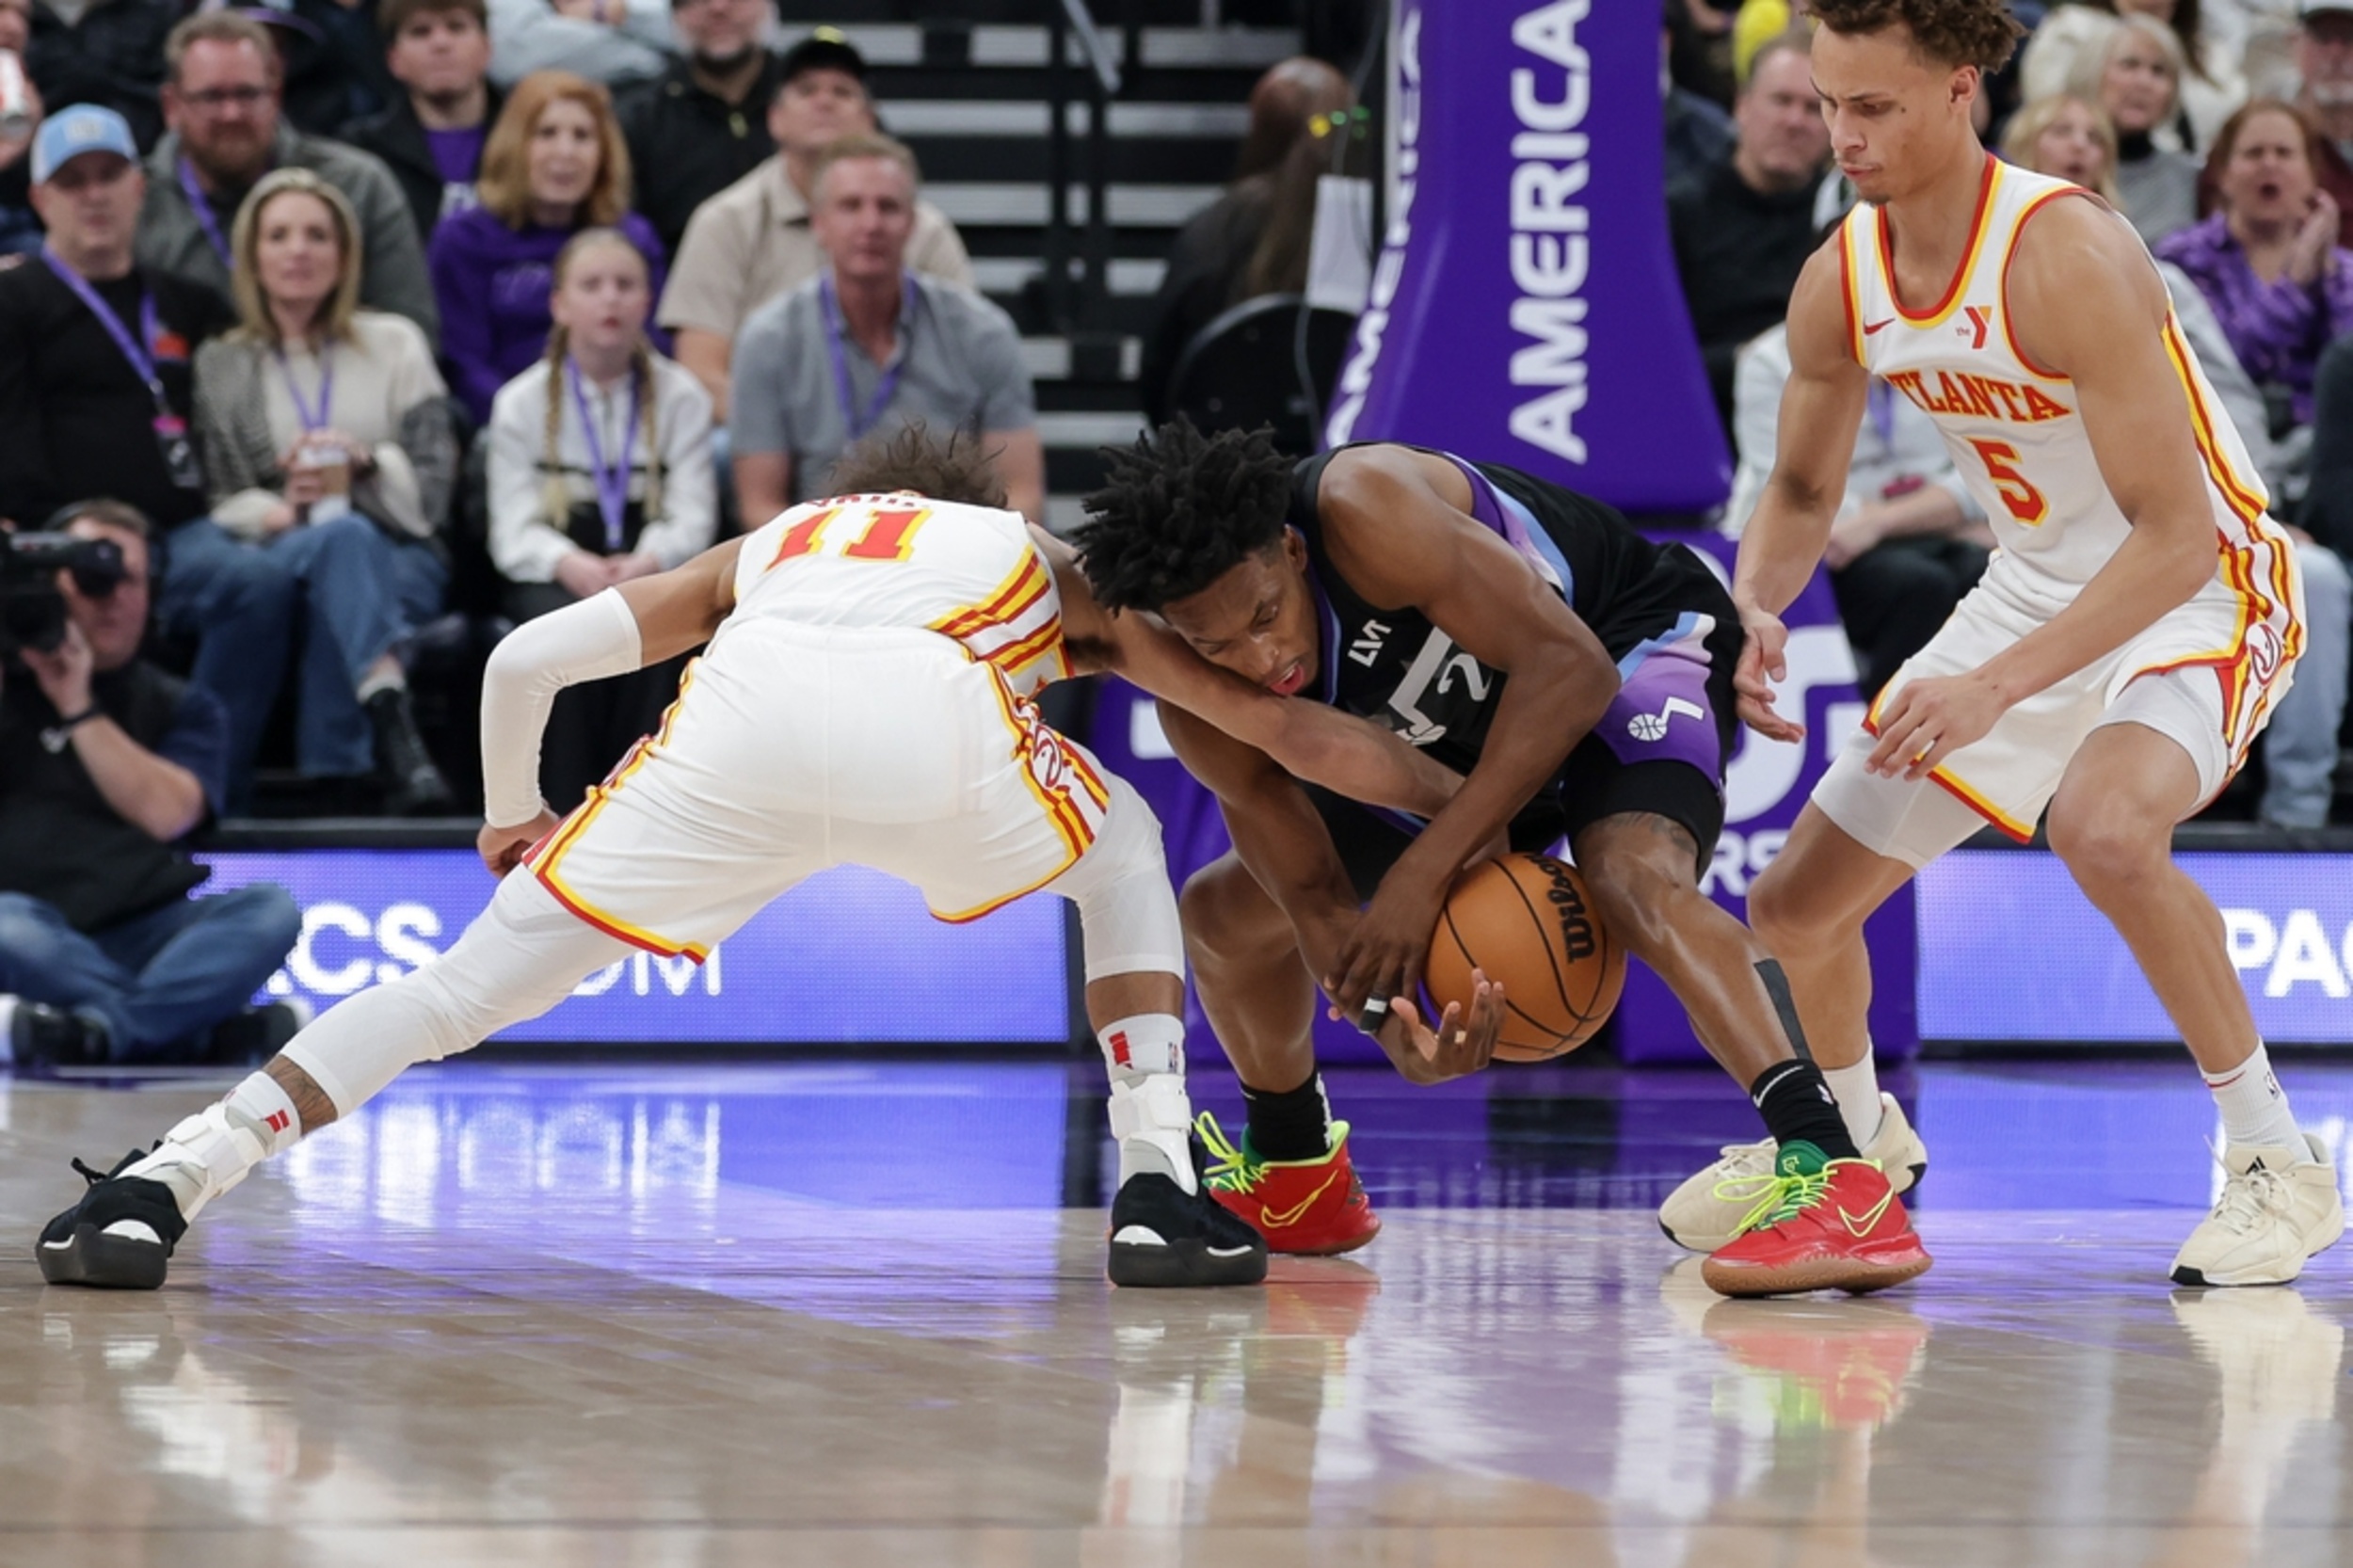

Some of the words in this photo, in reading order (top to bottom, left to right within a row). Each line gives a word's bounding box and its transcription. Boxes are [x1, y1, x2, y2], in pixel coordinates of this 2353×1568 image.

[1508, 0, 1591, 465] AMERICA
[1882, 368, 2073, 423] TLANTA
[1963, 437, 2050, 527] 5
[762, 506, 934, 574] 11
[1436, 652, 1495, 702] 2
[2218, 907, 2353, 1000] PA
